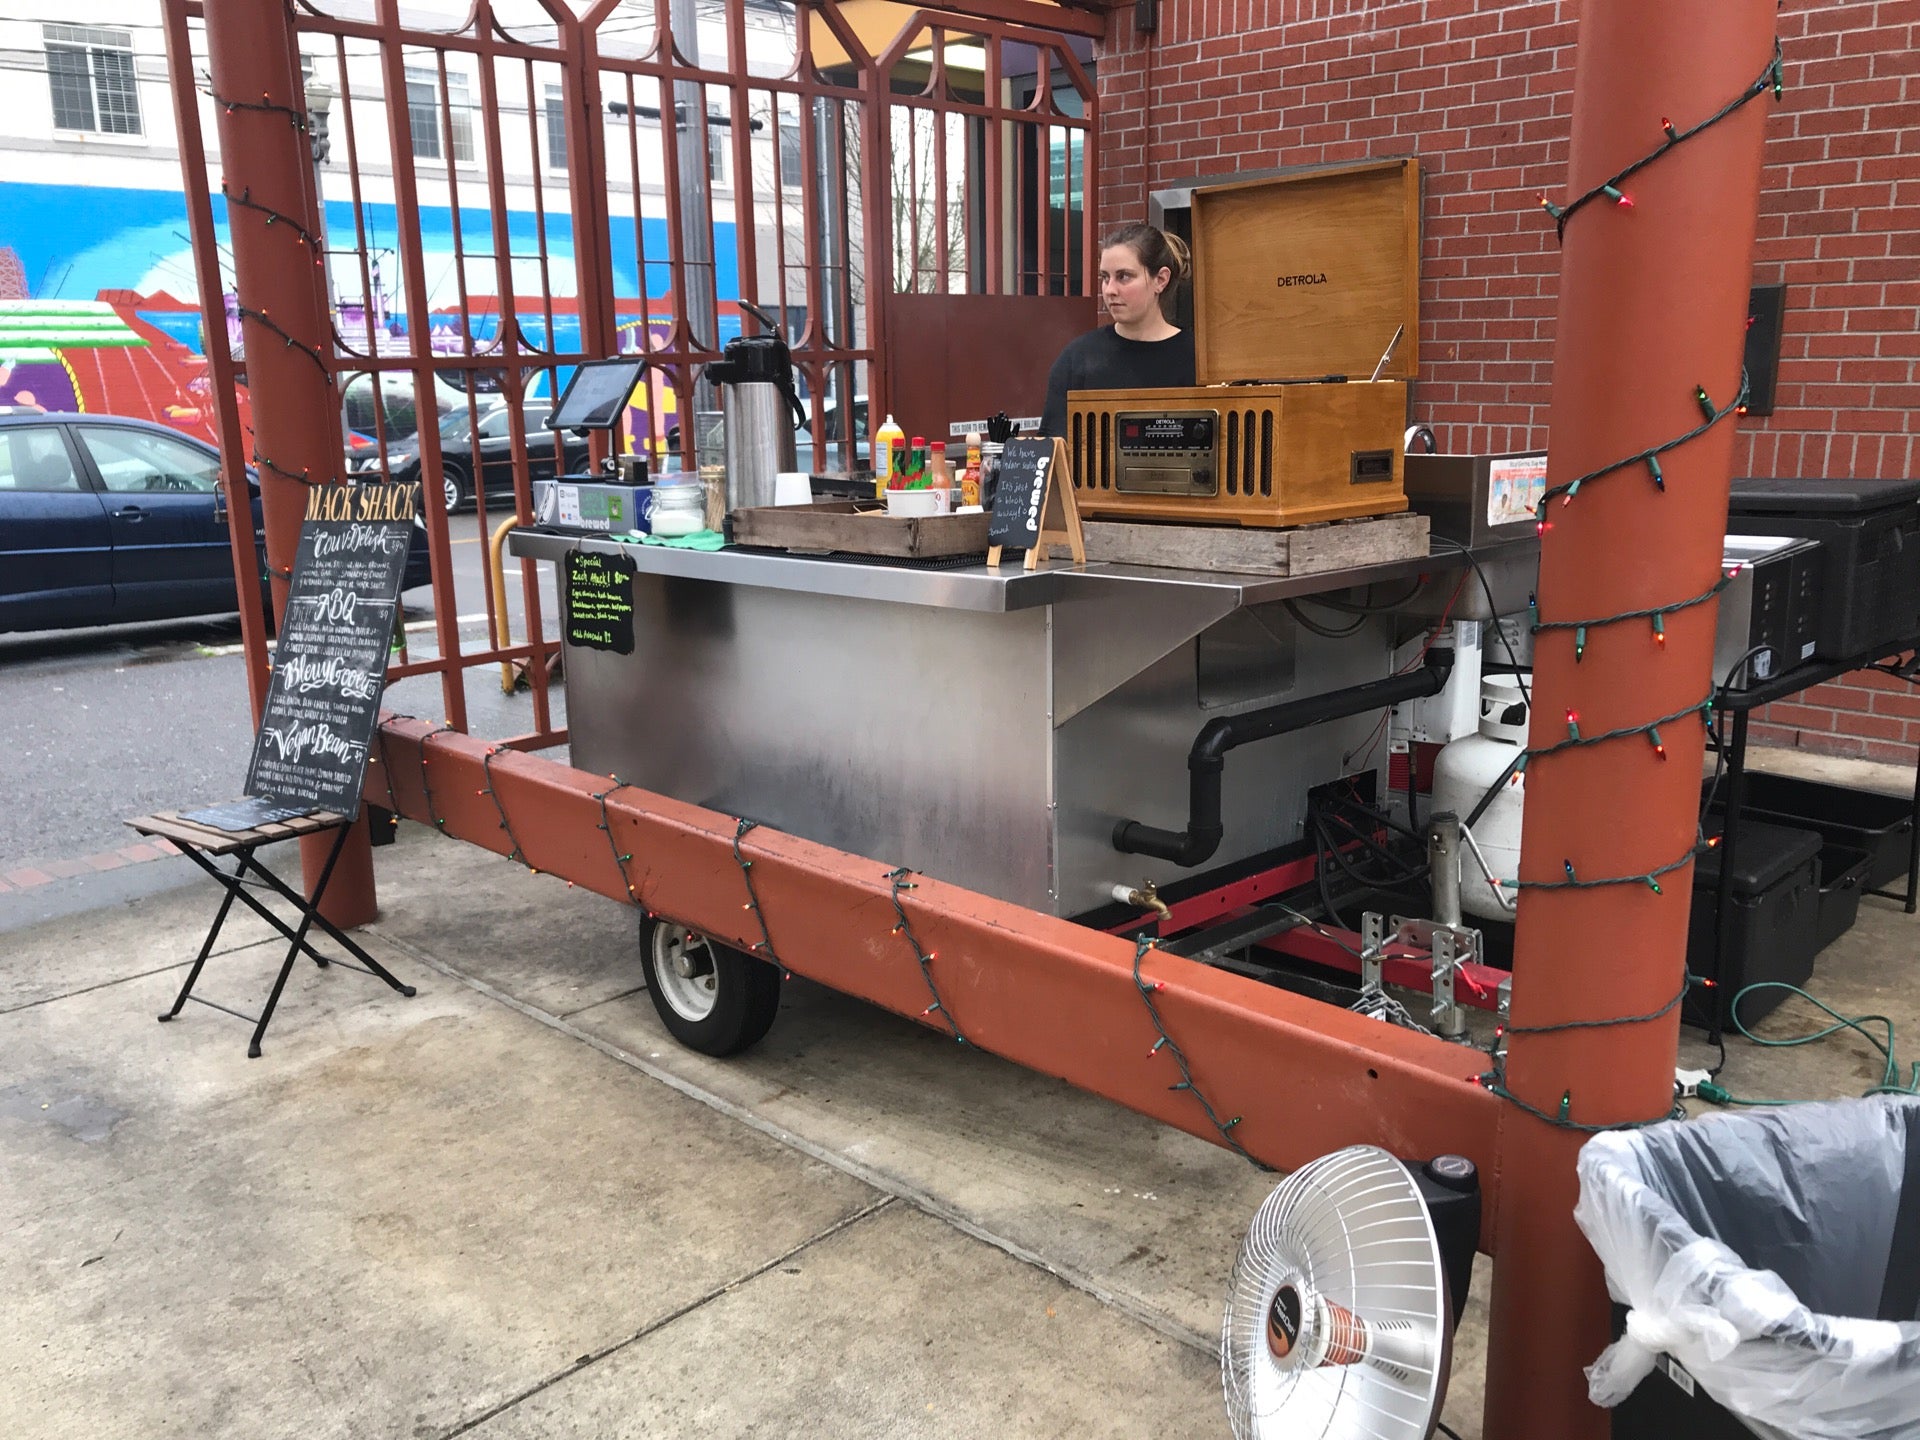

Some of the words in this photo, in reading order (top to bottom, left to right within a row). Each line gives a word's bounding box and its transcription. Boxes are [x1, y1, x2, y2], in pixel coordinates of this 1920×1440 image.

[1277, 273, 1327, 287] DETROLA
[304, 485, 356, 521] MACK
[356, 483, 419, 521] SHACK
[1026, 456, 1050, 532] brewed
[314, 588, 357, 626] ABQ
[310, 722, 352, 764] Bean
